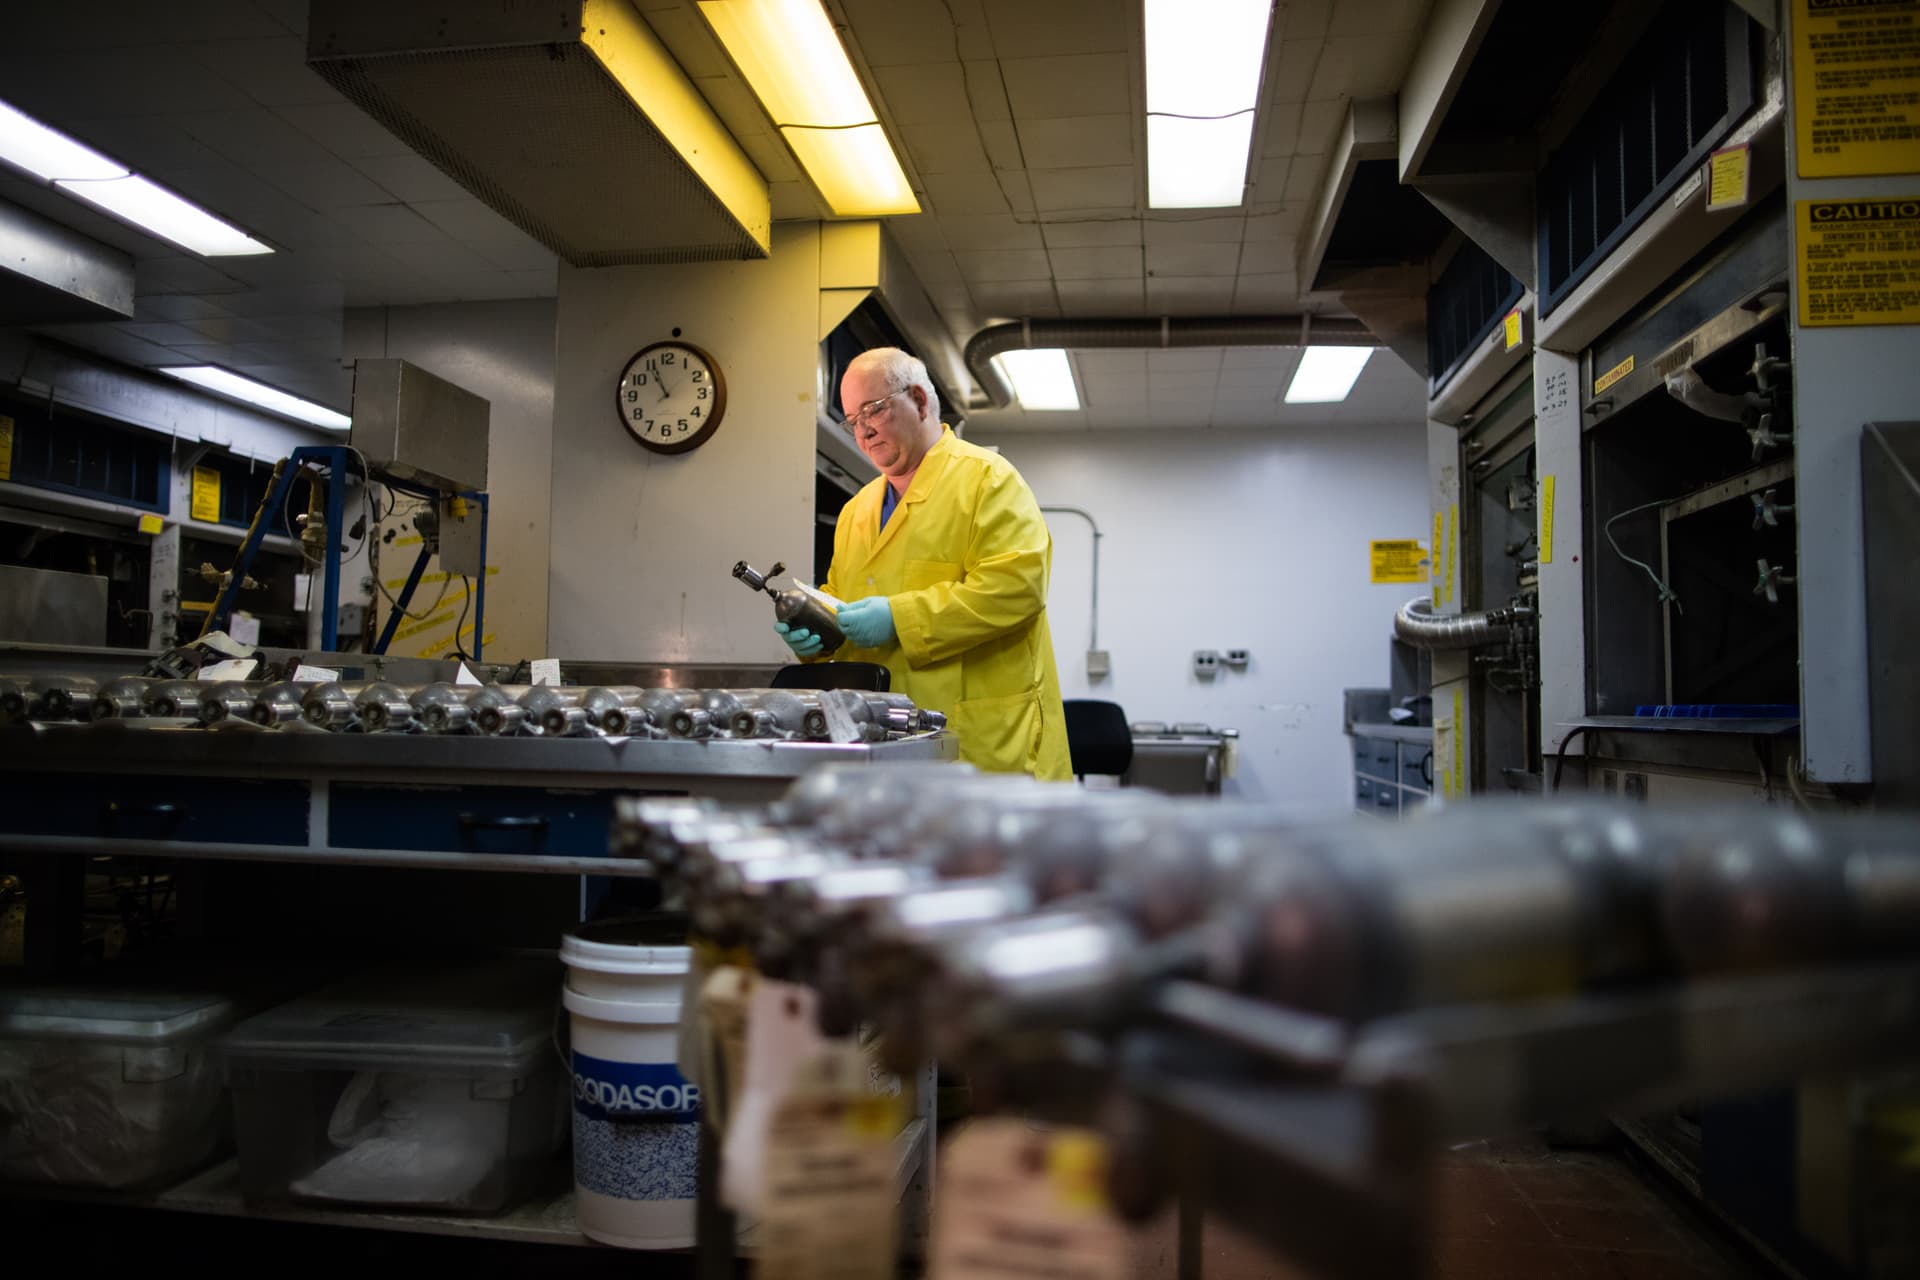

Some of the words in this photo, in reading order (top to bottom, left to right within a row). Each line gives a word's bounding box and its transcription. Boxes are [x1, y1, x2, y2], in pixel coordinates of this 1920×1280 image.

[646, 359, 656, 371] 11
[661, 353, 674, 365] 12
[683, 357, 688, 369] 1
[633, 374, 647, 386] 10
[692, 370, 702, 383] 2
[628, 390, 638, 402] 9
[697, 387, 707, 400] 3
[633, 408, 643, 420] 8
[690, 406, 700, 418] 4
[645, 420, 654, 432] 7
[661, 424, 671, 437] 6
[677, 419, 688, 431] 5
